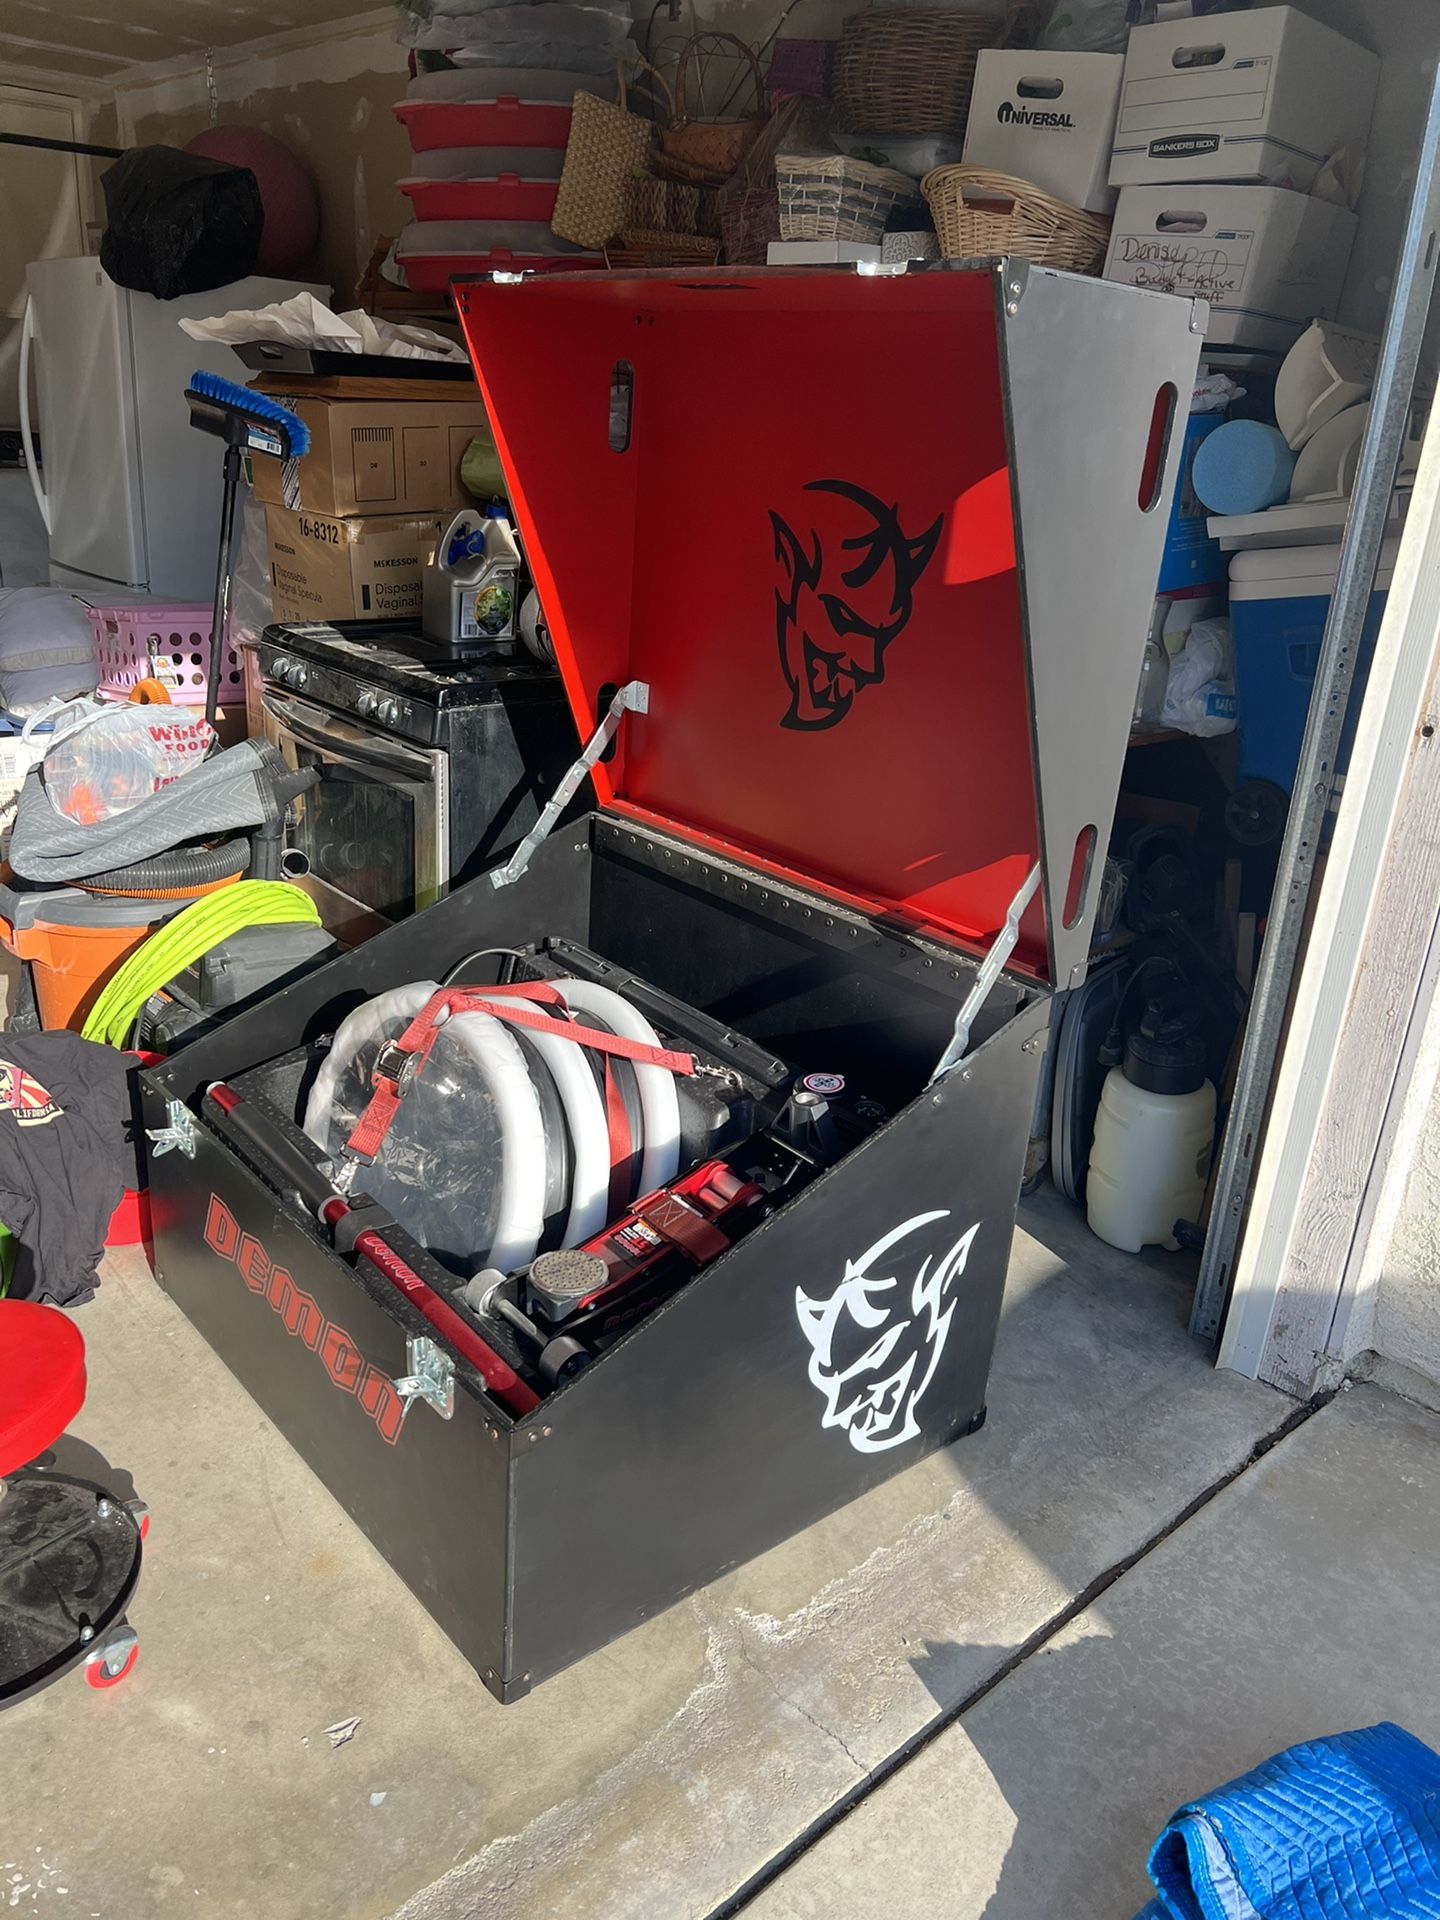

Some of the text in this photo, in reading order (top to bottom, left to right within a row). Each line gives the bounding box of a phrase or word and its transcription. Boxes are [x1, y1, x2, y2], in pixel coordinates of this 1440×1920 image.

[299, 517, 339, 544] 16-8312
[376, 595, 418, 611] Vaginal
[203, 1191, 405, 1445] DEMON
